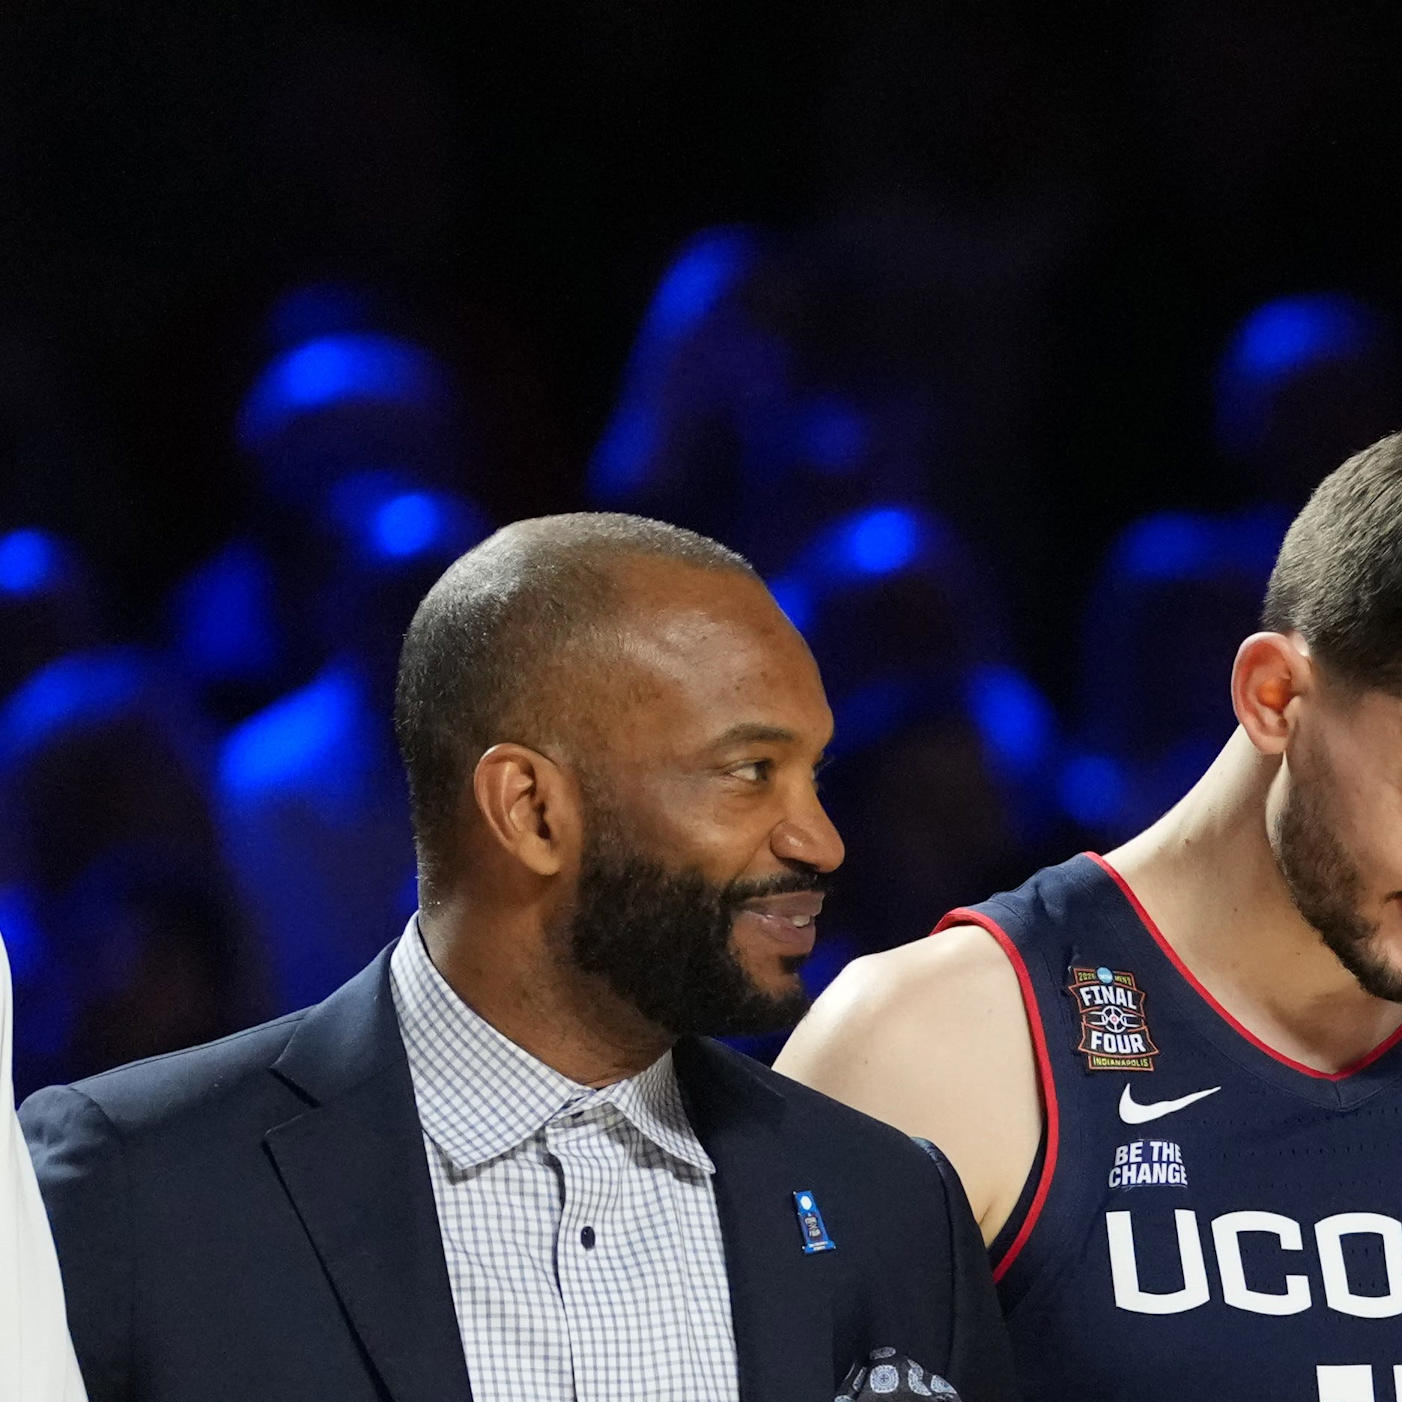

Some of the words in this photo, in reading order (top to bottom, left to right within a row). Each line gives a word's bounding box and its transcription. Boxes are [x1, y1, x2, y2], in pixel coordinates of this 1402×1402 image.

[1080, 985, 1137, 1010] FINAL
[1090, 1030, 1146, 1054] FOUR
[1093, 1056, 1149, 1067] INDIANAPOLIS
[1115, 1142, 1143, 1166] BE
[1150, 1141, 1183, 1164] THE
[1109, 1163, 1188, 1188] CHANGE
